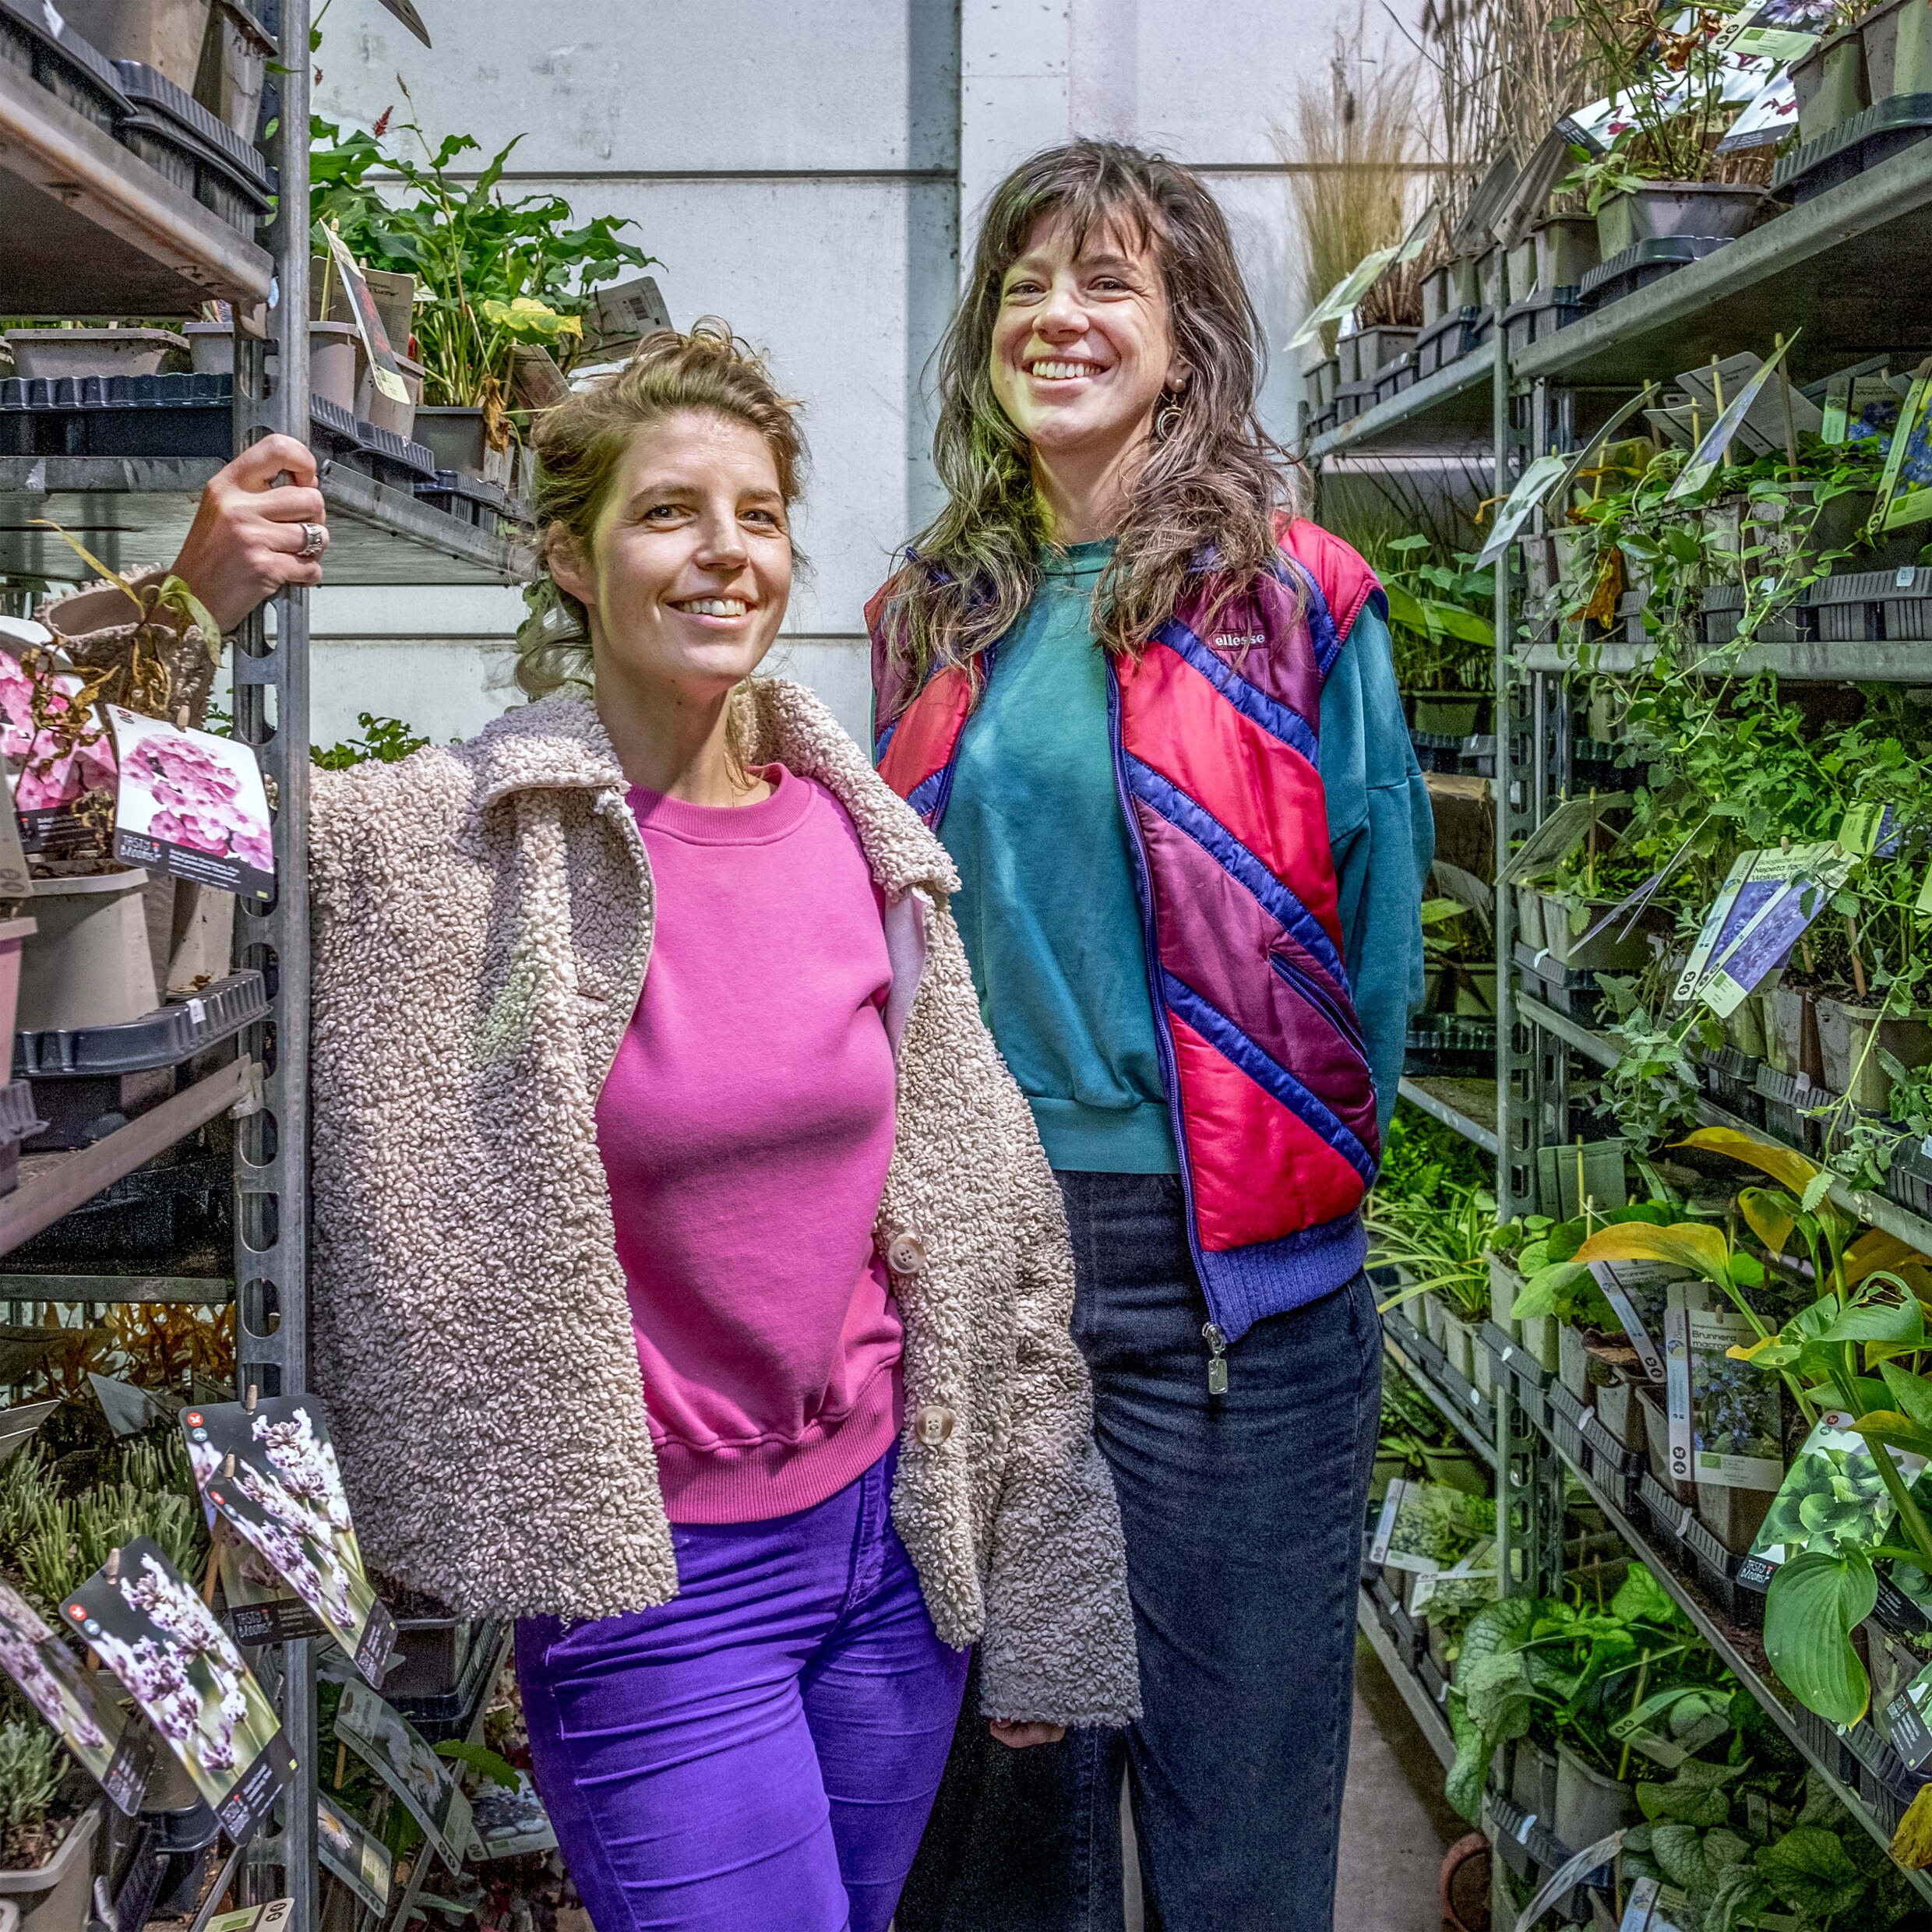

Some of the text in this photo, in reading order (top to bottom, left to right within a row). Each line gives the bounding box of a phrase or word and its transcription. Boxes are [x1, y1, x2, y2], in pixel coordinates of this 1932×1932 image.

[1215, 634, 1265, 646] ellesse
[1692, 1331, 1736, 1341] Brunnera
[1693, 1341, 1729, 1351] macrop
